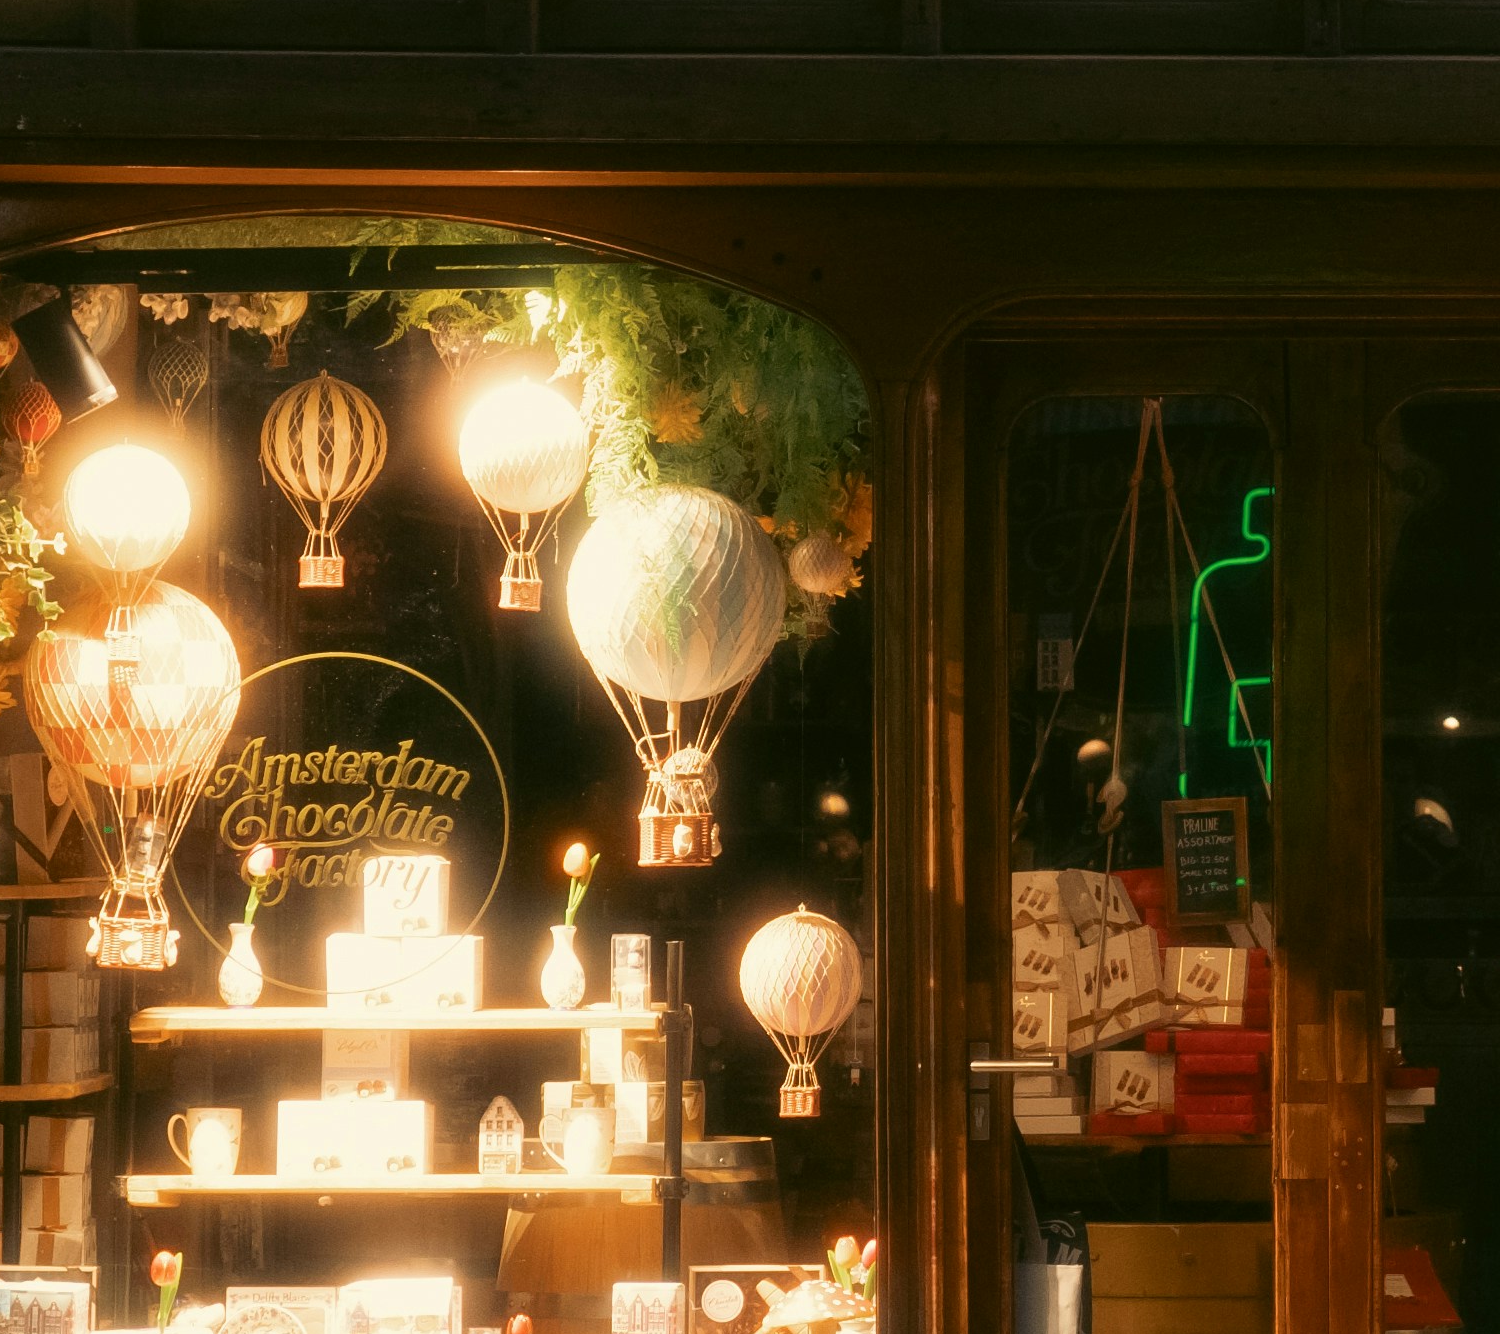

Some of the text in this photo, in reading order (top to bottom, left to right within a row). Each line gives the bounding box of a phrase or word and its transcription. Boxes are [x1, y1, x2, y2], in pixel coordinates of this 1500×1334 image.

[204, 736, 471, 801] Amsterdam
[219, 785, 454, 851] Chocolate
[1177, 835, 1235, 849] ASSORTMENT
[1182, 817, 1219, 835] PRALINE
[240, 839, 440, 909] Factory
